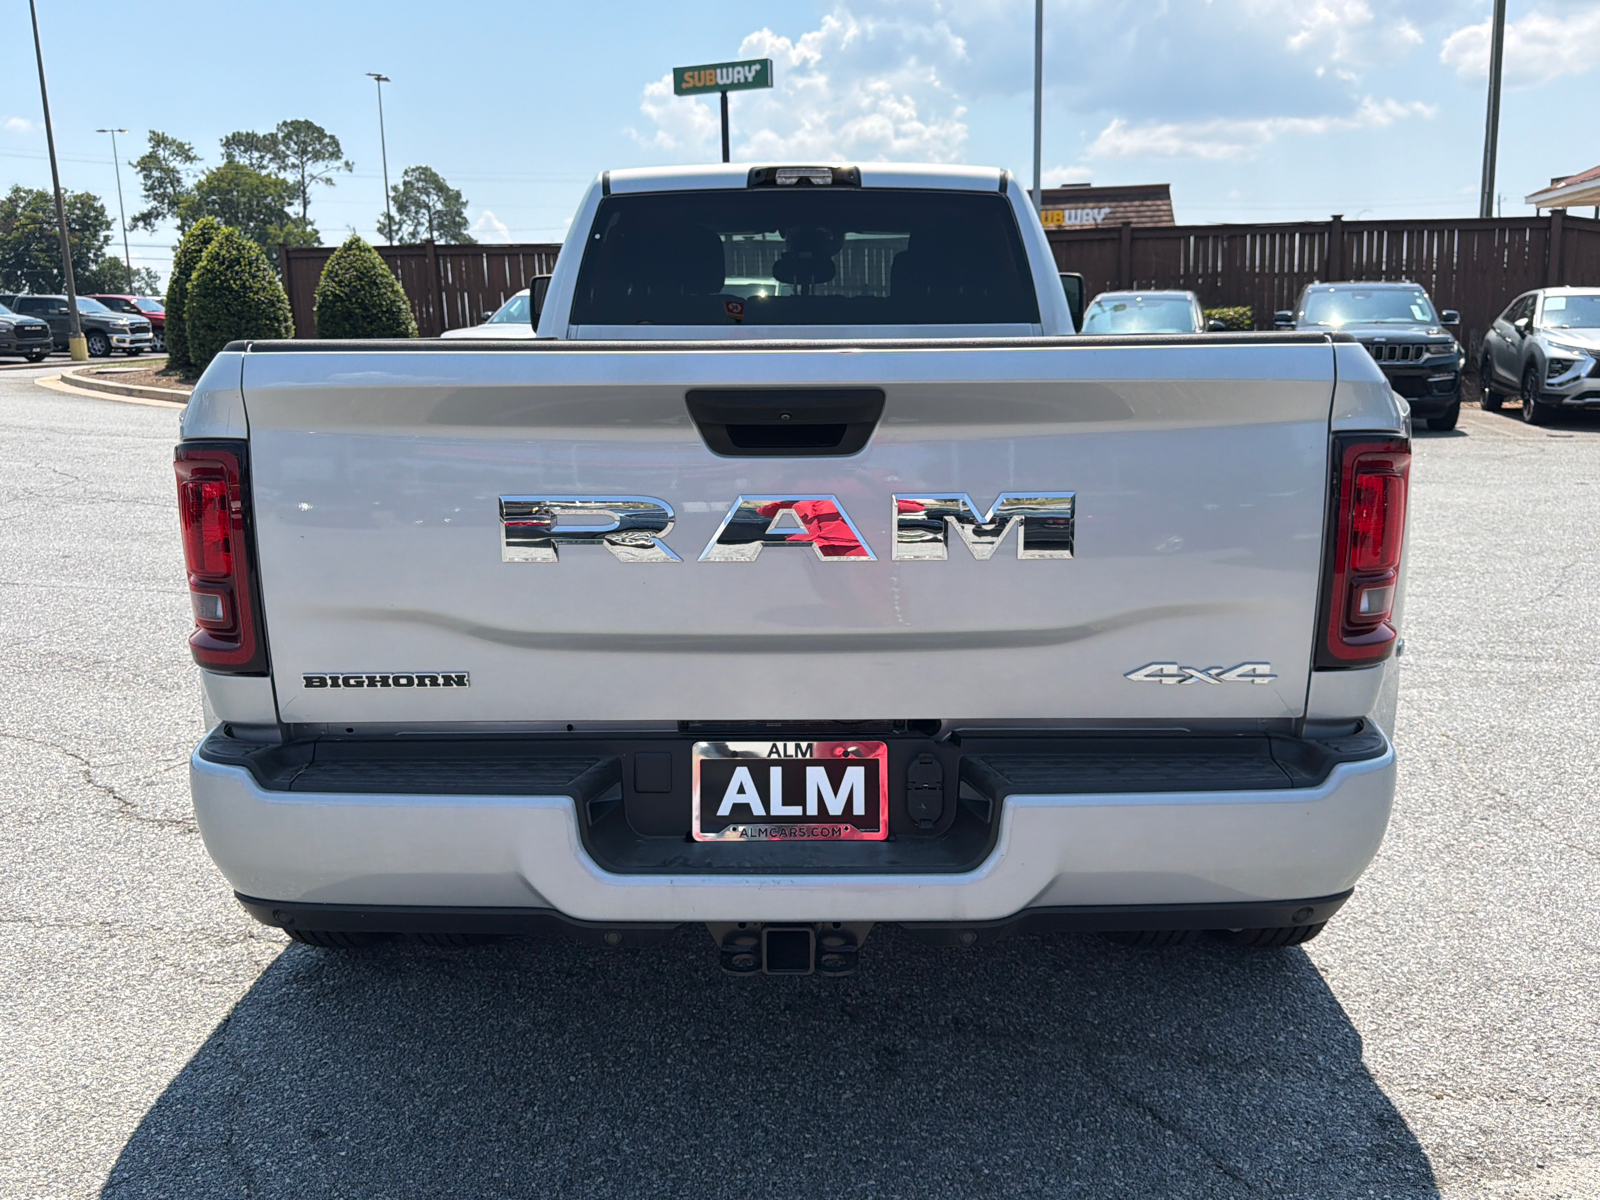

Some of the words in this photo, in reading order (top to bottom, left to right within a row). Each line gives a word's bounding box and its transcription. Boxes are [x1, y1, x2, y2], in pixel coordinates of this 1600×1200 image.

[681, 64, 761, 89] SUBWAY
[1041, 207, 1111, 226] UBWAY
[499, 491, 1076, 563] RAM
[302, 672, 471, 689] BIGHORN
[767, 743, 813, 758] ALM
[716, 766, 865, 816] ALM
[739, 827, 842, 838] ALMCARS.COM
